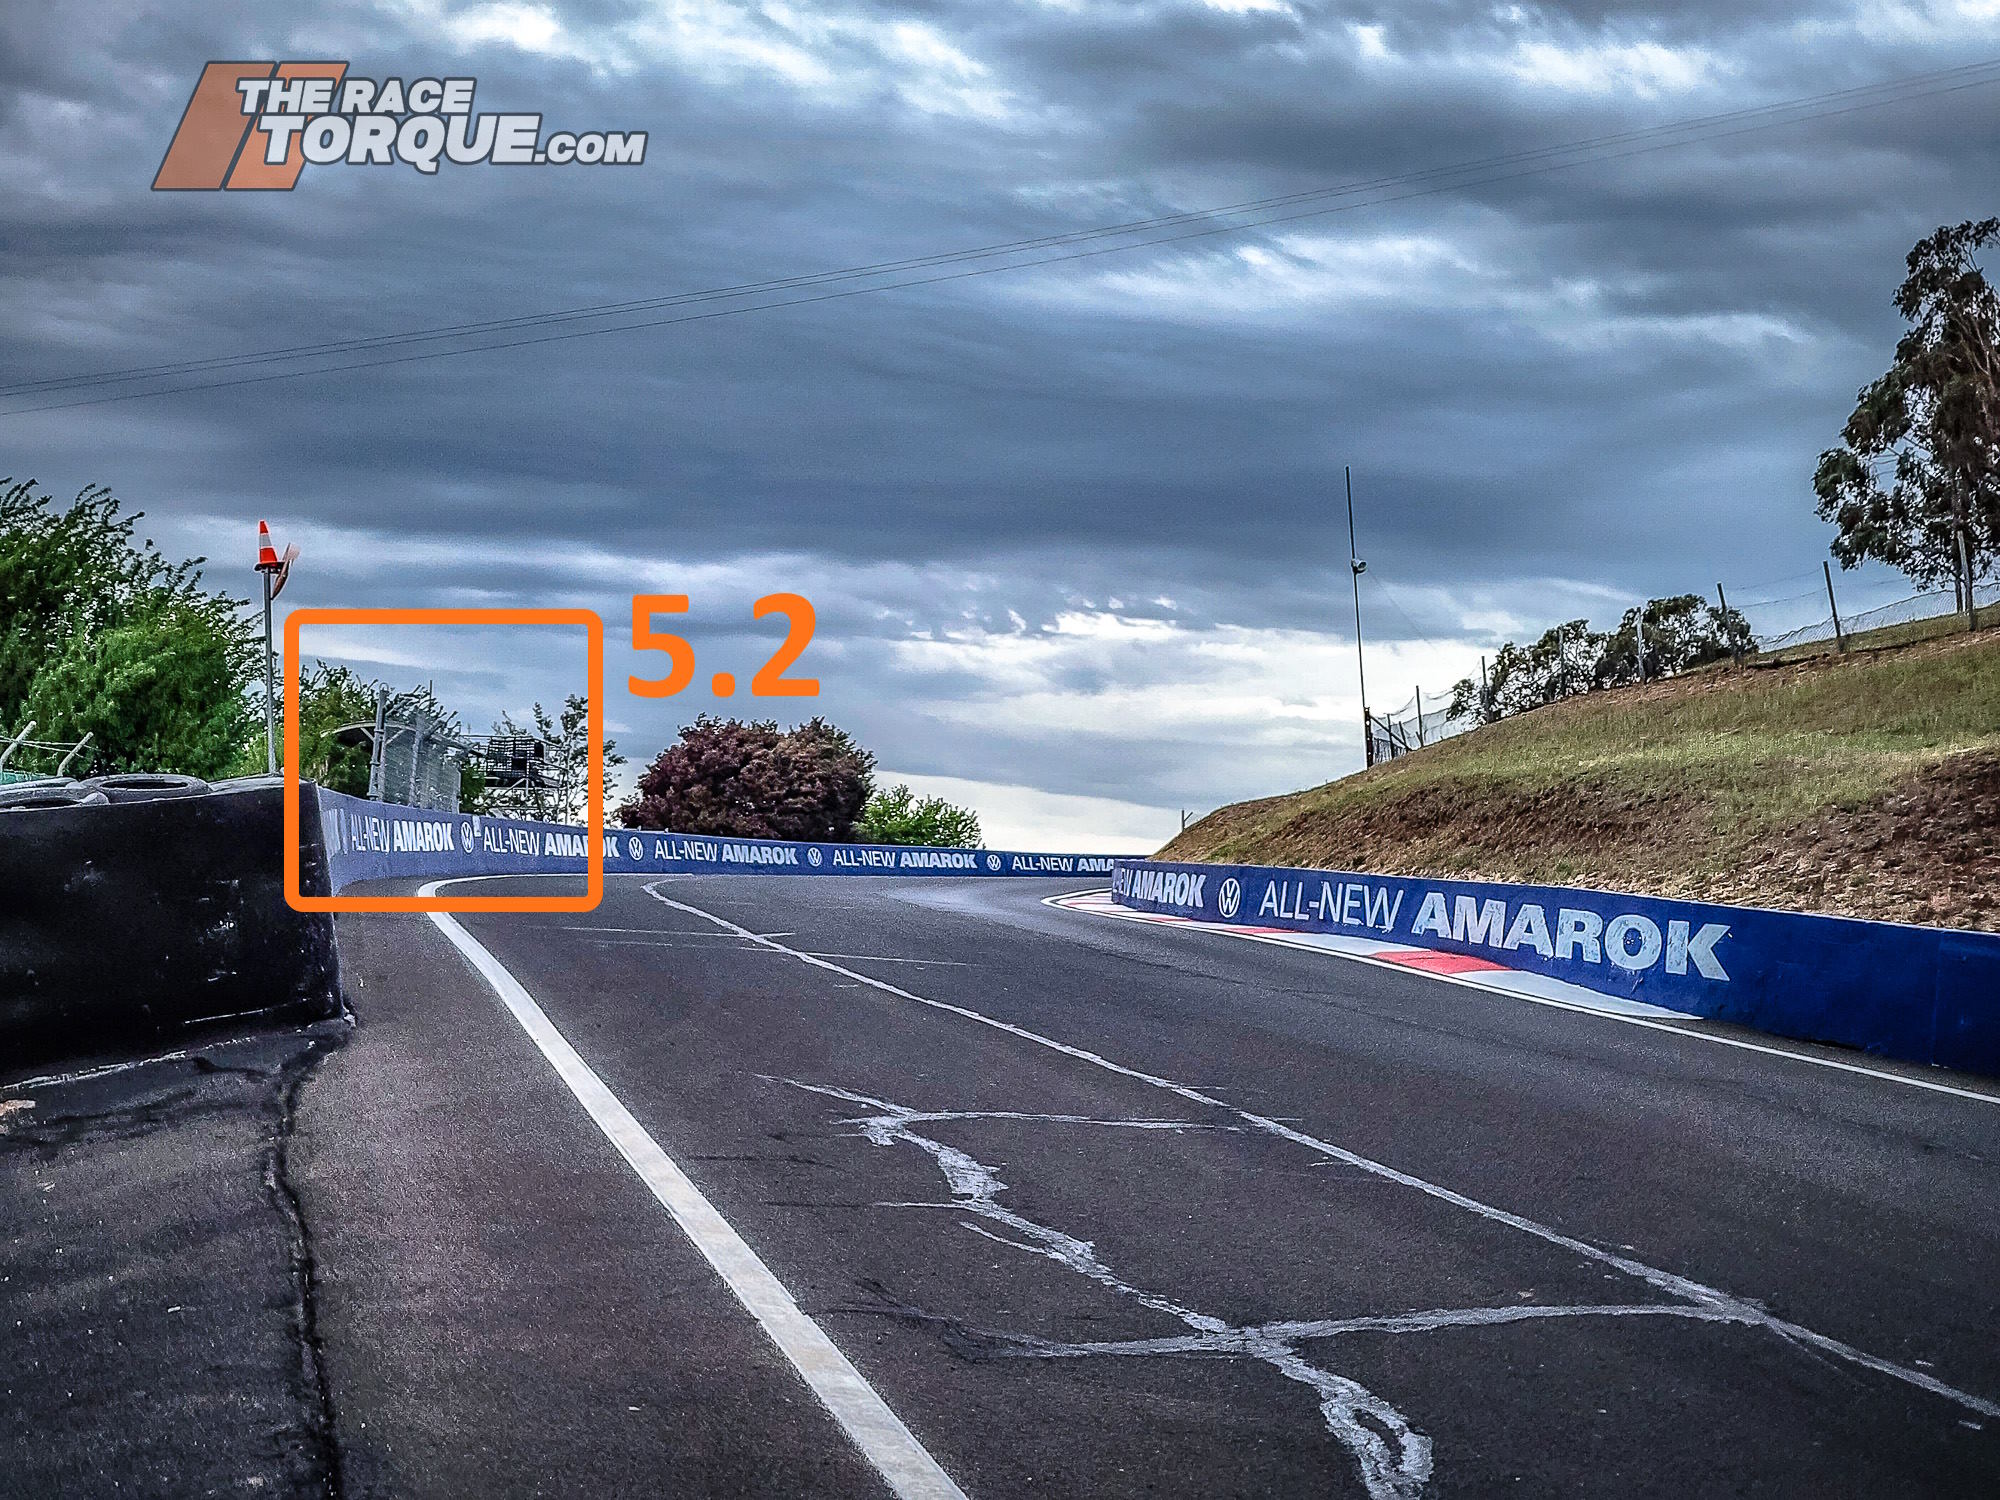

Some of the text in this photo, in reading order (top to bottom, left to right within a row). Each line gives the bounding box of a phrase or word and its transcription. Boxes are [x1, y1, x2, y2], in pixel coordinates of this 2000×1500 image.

[394, 820, 455, 852] AMAROK
[483, 826, 540, 857] ALL-NEW
[654, 839, 717, 862] ALL-NEW
[722, 843, 798, 865] AMAROK
[832, 849, 896, 868] ALL-NEW
[900, 851, 977, 869] AMAROK
[1012, 855, 1073, 872] ALL-NEW
[1077, 858, 1114, 872] AMA
[1131, 870, 1207, 908] AMAROK
[1258, 879, 1403, 932] ALL-NEW
[1411, 892, 1733, 981] AMAROK
